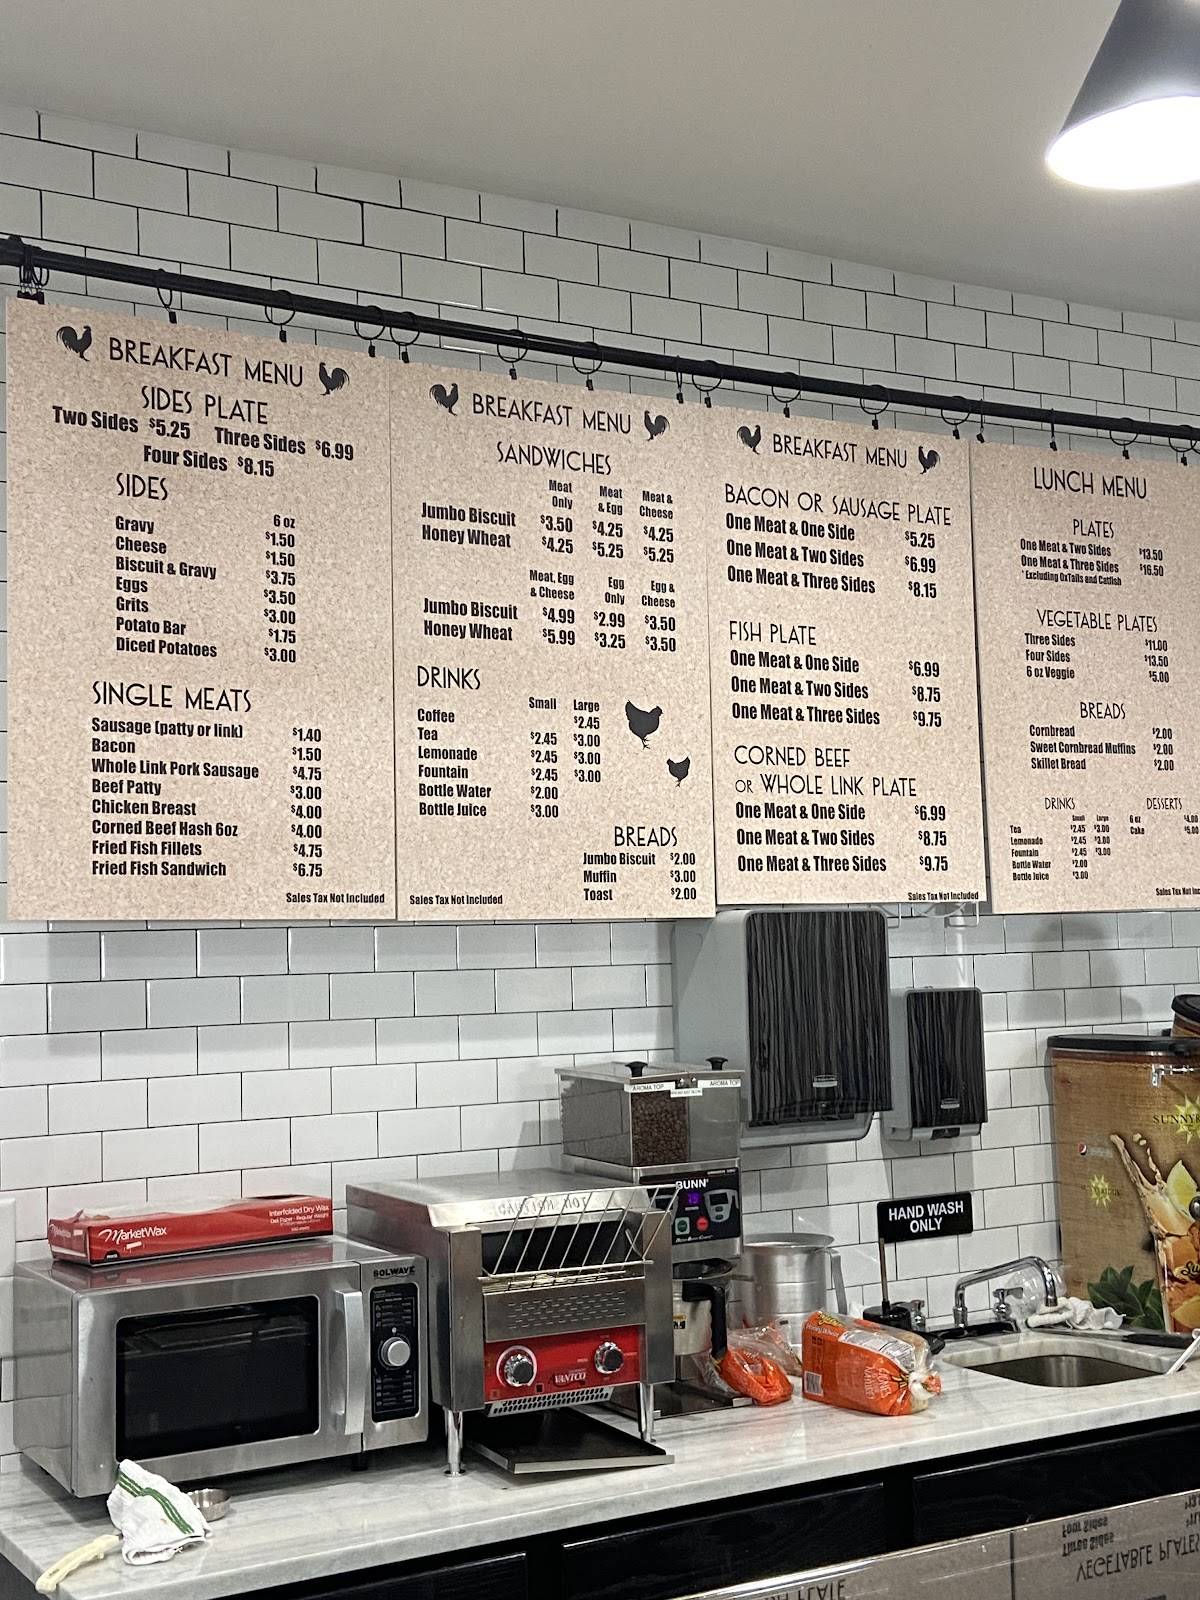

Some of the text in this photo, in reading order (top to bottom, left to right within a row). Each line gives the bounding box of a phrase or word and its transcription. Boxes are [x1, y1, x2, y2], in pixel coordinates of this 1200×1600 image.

[109, 337, 303, 387] BREAKFAST MENU
[141, 385, 268, 425] SIDES PLATE
[473, 393, 631, 434] BREAKFAST MENU
[52, 405, 354, 461] Two Sides $5.25 Three Sides $6.99
[144, 445, 274, 477] Four Sides $8.15
[497, 441, 611, 475] SANDWICHES
[773, 433, 907, 468] BREAKFAST MENU
[116, 472, 168, 501] SIDES
[549, 479, 572, 493] Meat
[1034, 467, 1147, 499] LUNCH MENU
[552, 496, 573, 510] Only
[642, 490, 673, 504] Meat &
[725, 483, 951, 526] BACON OR SAUSAGE PLATE
[421, 502, 673, 542] Jumbo Biscuit $3.50 $4.25 $4.25
[639, 505, 673, 519] Cheese
[115, 515, 295, 548] Gravy $1.50
[726, 513, 935, 549] One Meat & One Side $5.25
[1073, 519, 1114, 539] PLATES
[422, 524, 674, 563] Honey Wheat $4.25 $5.25 $5.25
[1020, 538, 1163, 561] One Meat & Two Sides $13.50
[116, 556, 296, 586] Biscuit & Gravy $3.75
[728, 565, 937, 598] One Meat & Three Sides $8.15
[1025, 570, 1059, 583] Excluding
[1085, 575, 1097, 584] and
[1036, 609, 1157, 633] VEGETABLE PLATES
[729, 620, 816, 646] FISH PLATE
[116, 636, 296, 663] Diced Potatoes $3.00
[1025, 649, 1168, 667] Four Sides $13.50
[417, 665, 480, 690] DRINKS
[92, 681, 251, 712] SINGLE MEATS
[529, 697, 600, 713] Small Large
[1080, 701, 1126, 719] BREADS
[92, 717, 321, 742] Sausage (patty or link) $1.40
[418, 745, 600, 765] Lemonade $2.45 $3.00
[734, 745, 850, 767] CORNED BEEF
[1030, 741, 1173, 755] Sweet Cornbread Muffins $2.00
[91, 758, 321, 781] Whole Link Pork Sausage $4.75
[735, 773, 917, 797] OR WHOLE LINK PLATE
[419, 802, 558, 818] Bottle Juice $3.00
[1045, 797, 1075, 810] DRINKS
[1146, 797, 1182, 810] DESSERTS
[614, 826, 677, 847] BREADS
[737, 828, 947, 846] One Meat & Two Sides $8.75
[1010, 824, 1110, 834] Tea $2.45 $3.00
[1130, 826, 1199, 835] Cake $5.00
[583, 870, 696, 883] Muffin $3.00
[286, 892, 385, 903] Sales Tax Not Included
[583, 887, 696, 901] Toast $2.00
[675, 1179, 707, 1190] BUNN
[269, 1204, 330, 1217] Interfolded Dry Wax
[888, 1200, 964, 1222] HAND WASH
[98, 1226, 167, 1245] MarketWax
[909, 1217, 943, 1233] ONLY
[373, 1266, 416, 1277] SOLWAVE
